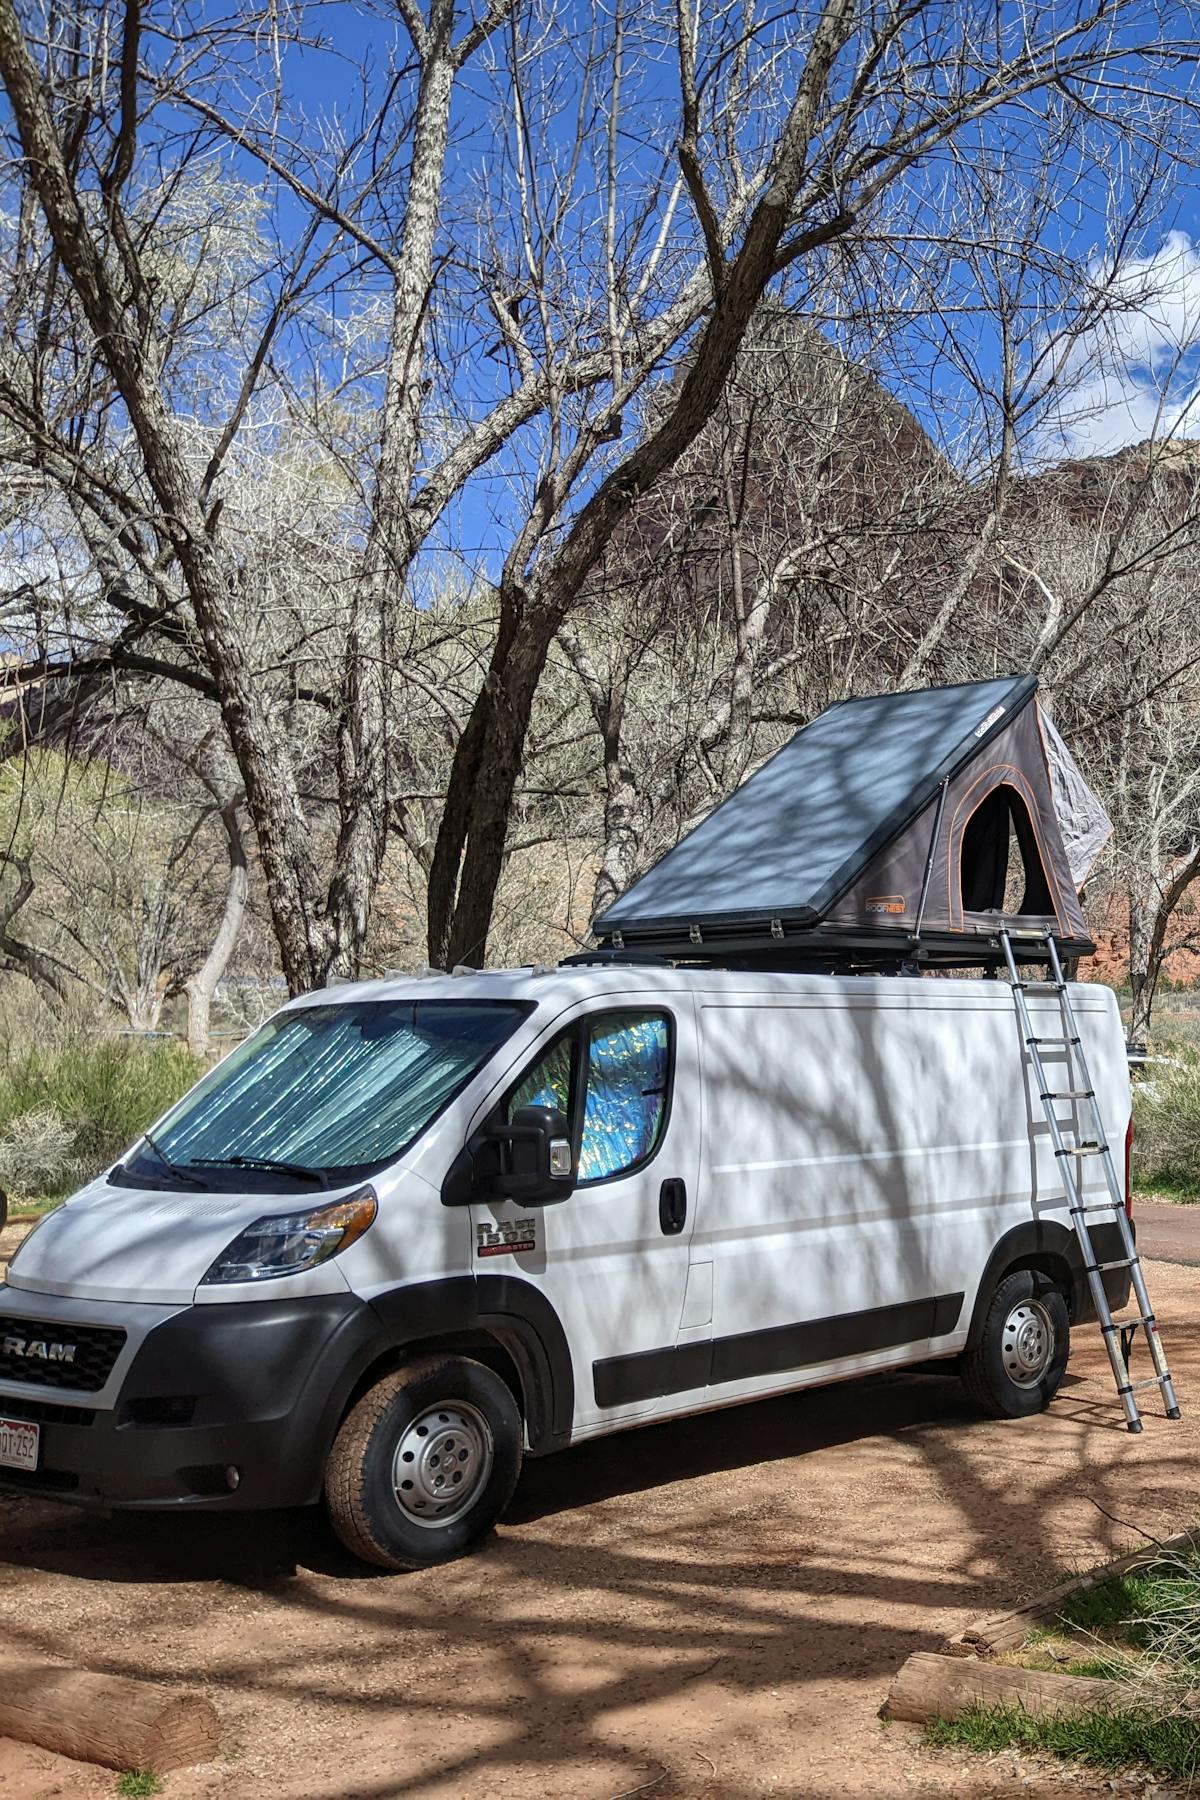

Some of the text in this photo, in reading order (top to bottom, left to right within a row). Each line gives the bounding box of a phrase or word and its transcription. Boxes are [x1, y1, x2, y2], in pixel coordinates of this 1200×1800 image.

[865, 903, 905, 913] ROOFNEST
[477, 1218, 535, 1234] RAM
[477, 1229, 535, 1246] 1500
[3, 1336, 77, 1362] RAM
